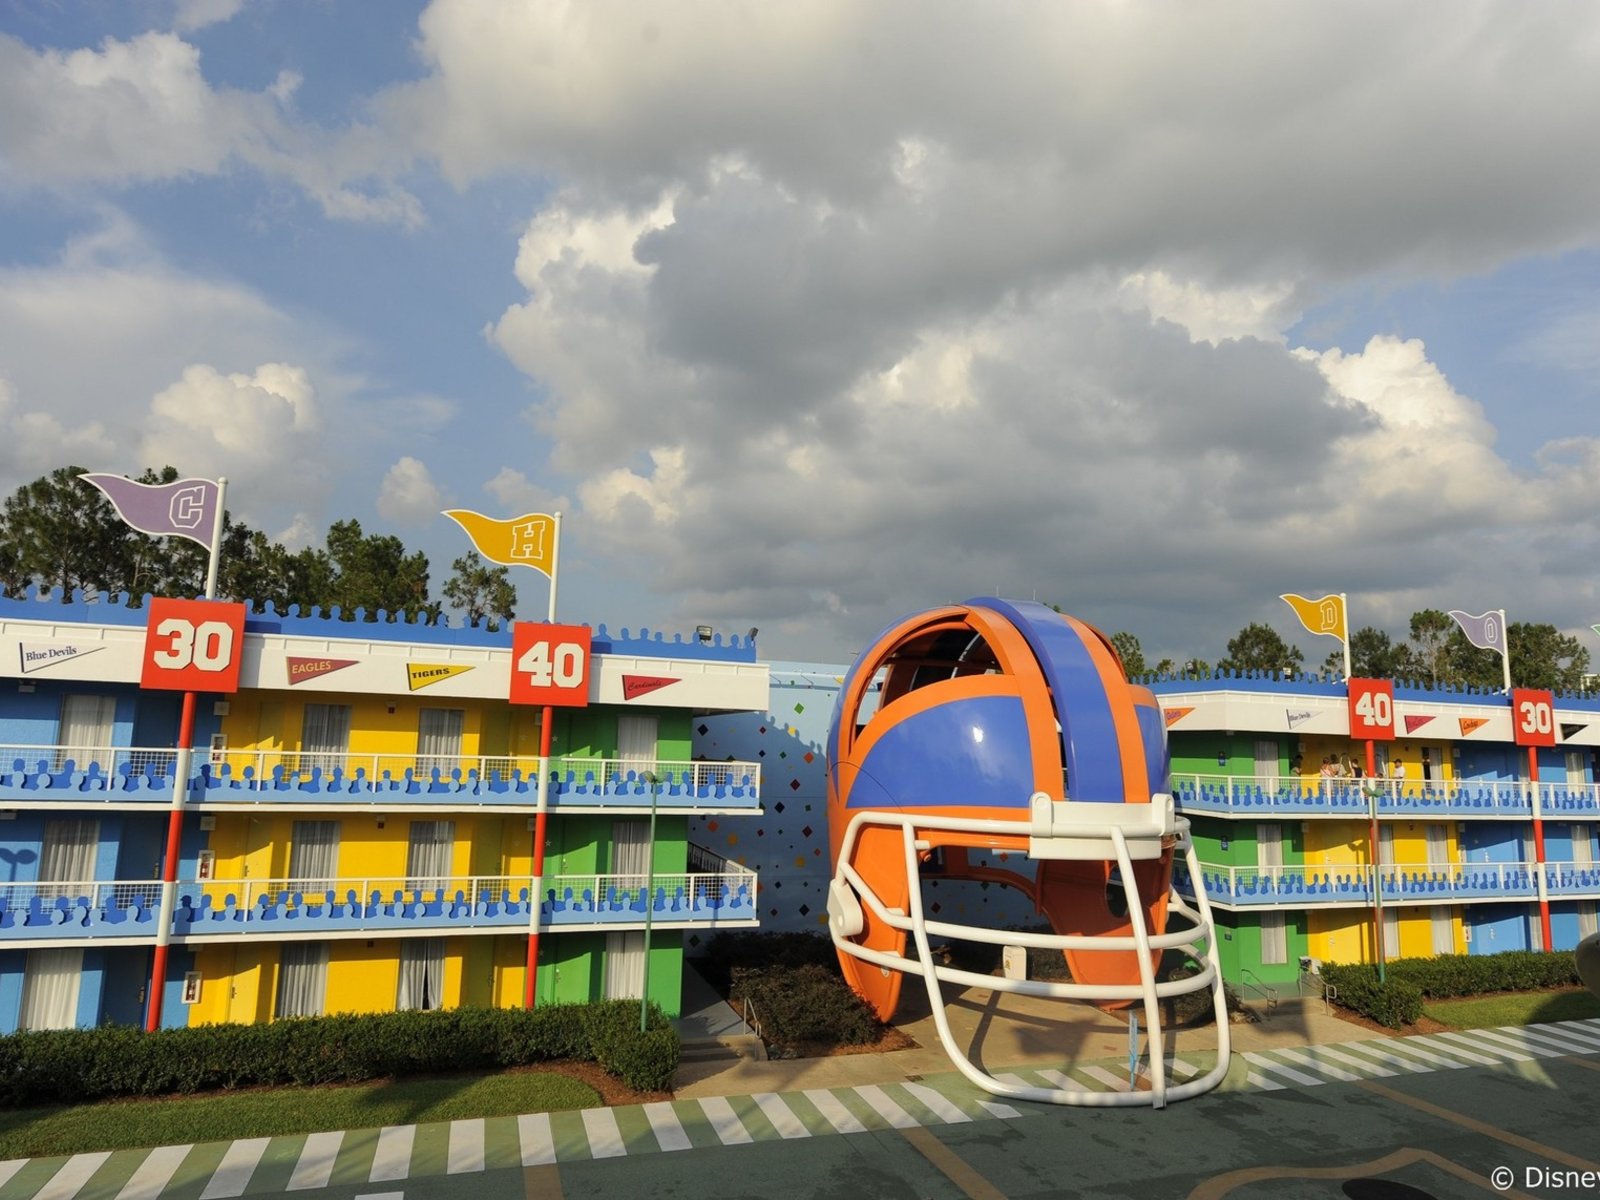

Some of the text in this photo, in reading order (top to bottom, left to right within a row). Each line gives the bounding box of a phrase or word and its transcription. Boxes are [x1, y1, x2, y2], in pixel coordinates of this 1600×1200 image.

[169, 485, 206, 529] C
[510, 520, 546, 560] H
[1320, 599, 1338, 631] D
[25, 645, 77, 662] Blue Devils
[153, 618, 234, 672] 30
[291, 659, 332, 675] EAGLES
[411, 667, 450, 679] TIGERS
[518, 641, 585, 689] 40
[627, 679, 662, 692] Cardinals
[1355, 692, 1392, 727] 40
[1520, 701, 1552, 735] 30
